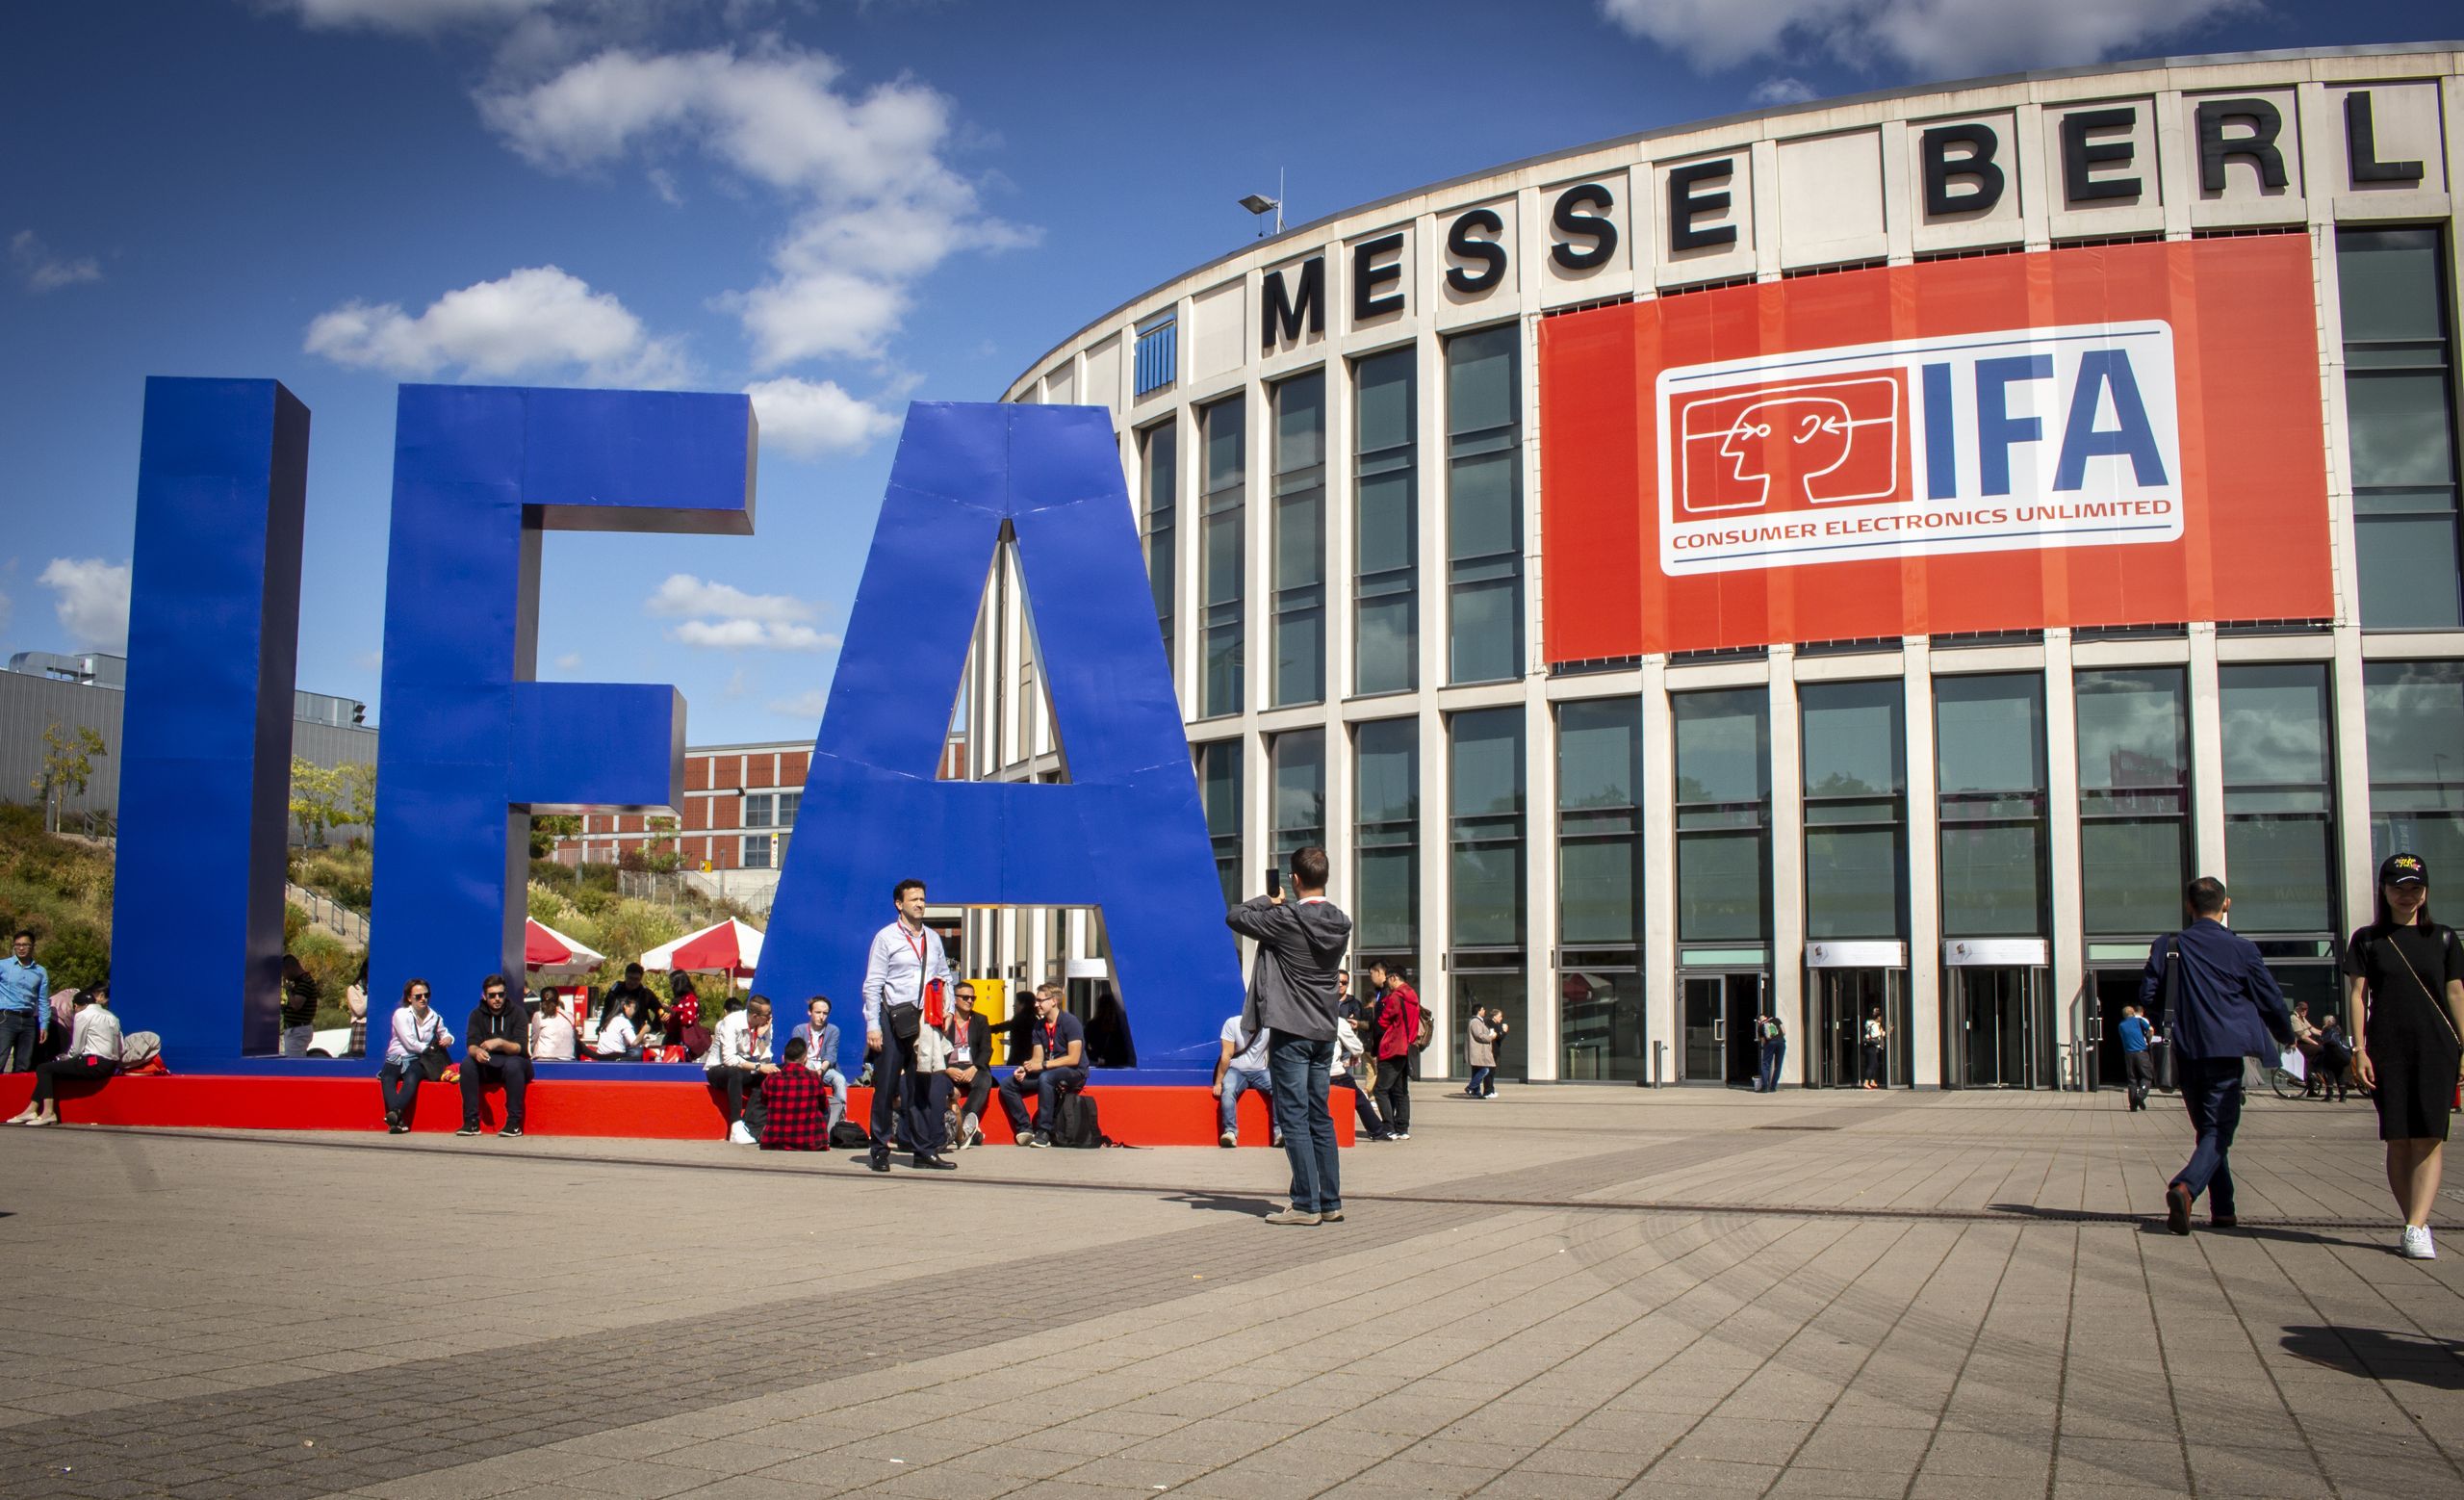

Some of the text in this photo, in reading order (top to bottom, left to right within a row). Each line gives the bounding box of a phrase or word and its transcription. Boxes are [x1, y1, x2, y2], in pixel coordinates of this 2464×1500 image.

[1262, 91, 2425, 348] MESSE BERL
[1673, 500, 2171, 550] CONSUMER ELECTRONICS UNLIMITED
[1922, 349, 2169, 500] IFA
[112, 374, 1245, 1071] IFA
